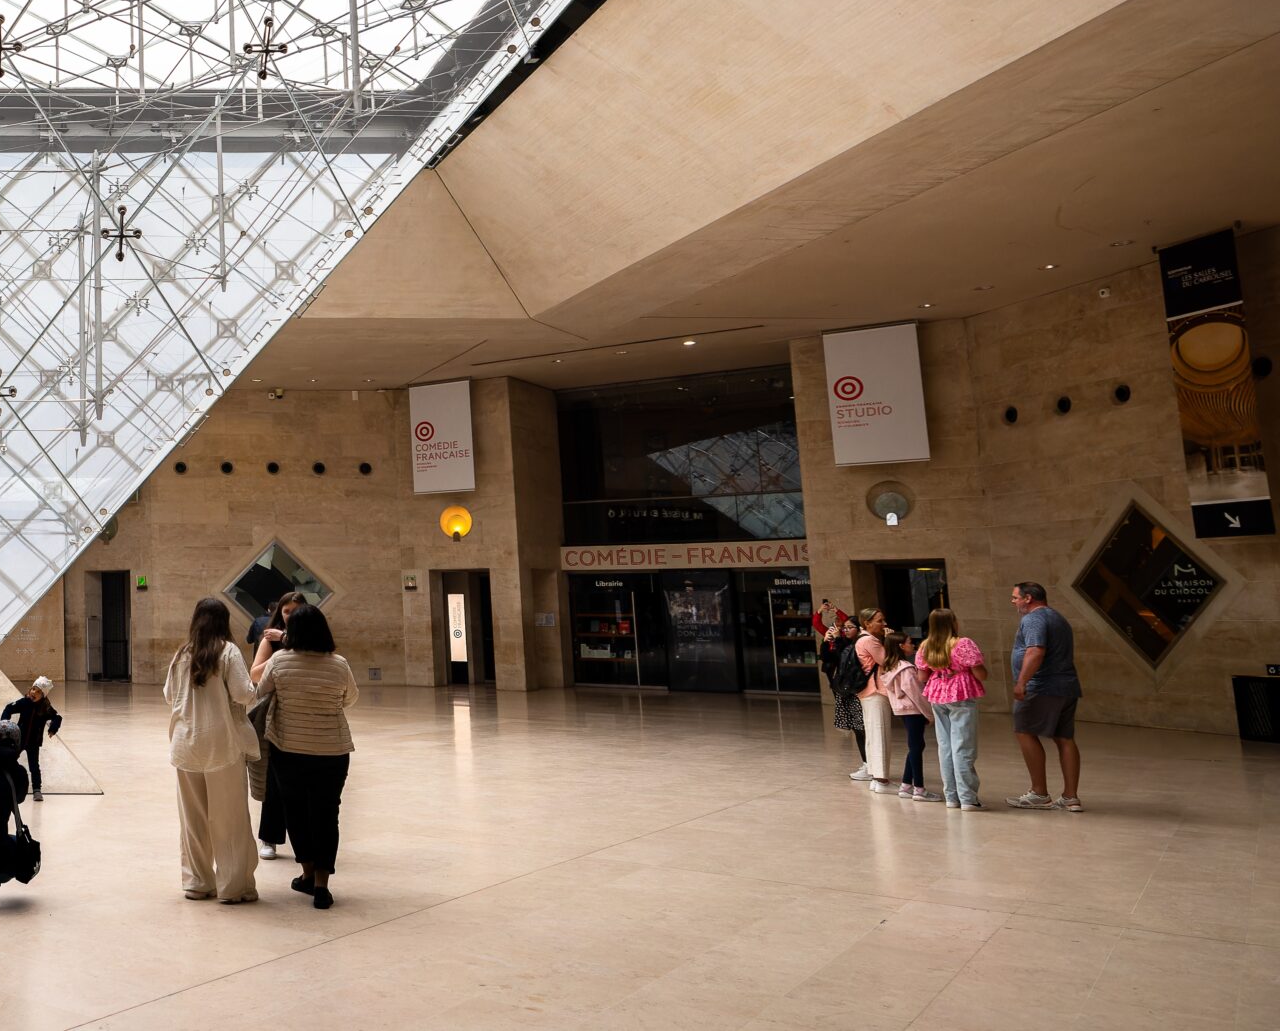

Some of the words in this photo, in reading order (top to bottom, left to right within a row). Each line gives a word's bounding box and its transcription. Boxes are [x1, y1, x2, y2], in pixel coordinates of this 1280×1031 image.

[837, 405, 892, 419] STUDIO
[416, 441, 458, 452] COMÉDIE
[416, 449, 470, 461] FRANÇAISE
[1176, 579, 1213, 587] MAISON
